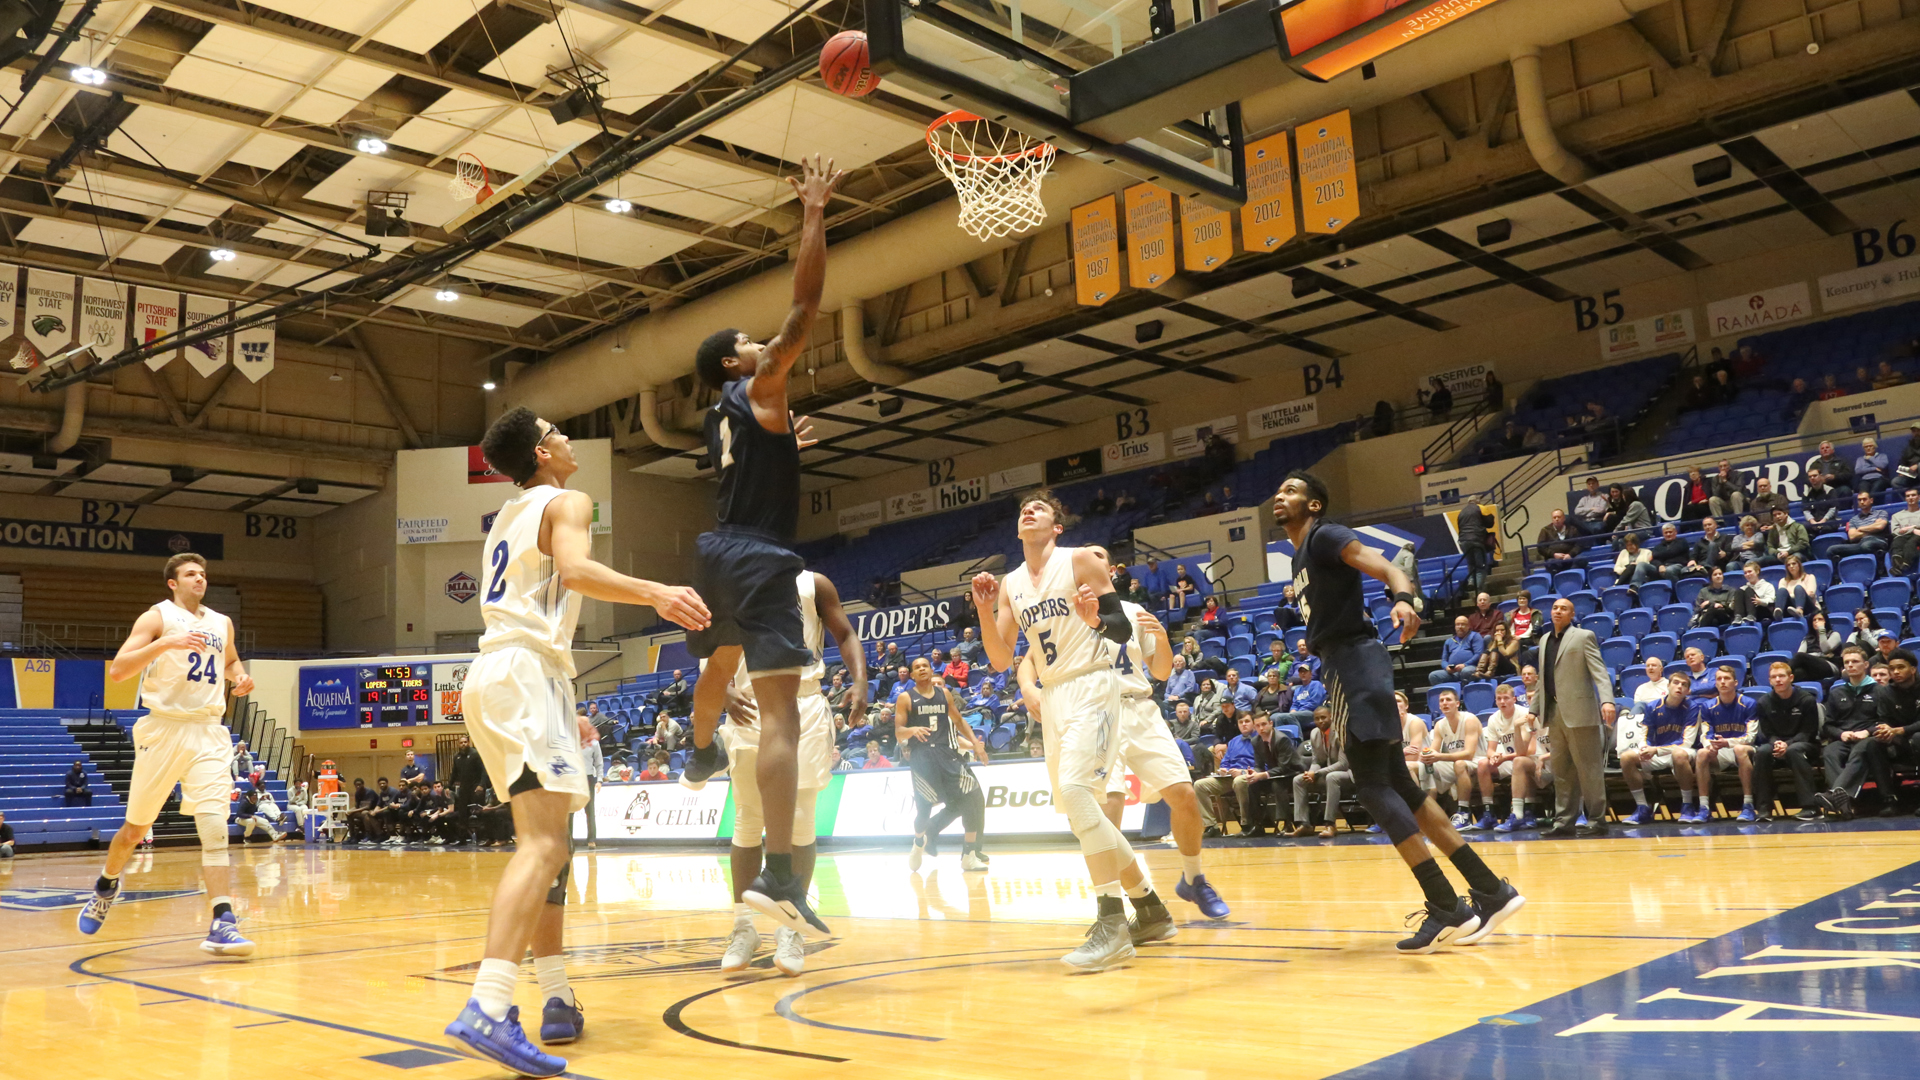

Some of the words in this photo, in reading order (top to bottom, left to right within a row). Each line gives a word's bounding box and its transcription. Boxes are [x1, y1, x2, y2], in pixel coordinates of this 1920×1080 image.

[1303, 136, 1347, 159] NATIONAL
[1300, 147, 1353, 175] CHAMPIONS
[1246, 167, 1291, 192] HAMPIONS
[1315, 179, 1345, 204] 2013
[1130, 198, 1167, 219] NATIONAL
[1254, 199, 1282, 224] 2012
[1077, 218, 1112, 239] NATIONAL
[1127, 210, 1172, 234] CHAMPIONS
[1193, 220, 1222, 244] 2008
[1075, 227, 1117, 253] CHAMPIONS
[1140, 238, 1165, 261] 1990
[1853, 218, 1917, 268] B6
[1086, 257, 1109, 279] 1987
[28, 287, 73, 302] NORTHEASTERN
[1826, 279, 1878, 298] Kearney
[38, 297, 62, 310] STATE
[83, 295, 126, 310] NORTHWEST
[85, 305, 122, 320] MISSOURI
[137, 302, 177, 318] PITTSBURG
[1573, 289, 1625, 332] B5
[146, 315, 168, 327] STATE
[1717, 303, 1802, 332] RAMADA
[1303, 358, 1344, 396] B4
[1261, 402, 1314, 422] NUTTELMAN
[1262, 414, 1301, 430] FENCING
[1115, 408, 1150, 441] B3
[719, 415, 735, 470] 1
[1119, 440, 1149, 457] Trius
[928, 458, 956, 487] B2
[82, 500, 139, 527] B27
[811, 490, 832, 515] B1
[246, 514, 297, 539] B28
[397, 518, 449, 529] FAIRFIELD
[406, 534, 438, 544] Marriott
[482, 540, 509, 606] 2
[447, 582, 477, 592] MIAA
[856, 601, 951, 642] LOPERS
[1019, 597, 1070, 633] LOPERS
[1038, 628, 1058, 666] 5
[24, 659, 51, 673] A26
[186, 651, 217, 685] 24
[1109, 643, 1133, 676] 4
[385, 667, 411, 679] 4:53
[401, 679, 422, 688] TIGERS
[365, 681, 387, 689] LOPERS
[413, 689, 428, 701] 26
[434, 682, 455, 692] Little
[305, 686, 352, 709] AQUAFINA
[368, 691, 379, 702] 19
[365, 711, 372, 723] 3
[917, 704, 946, 715] LINCOLN
[656, 808, 718, 826] CELLAR
